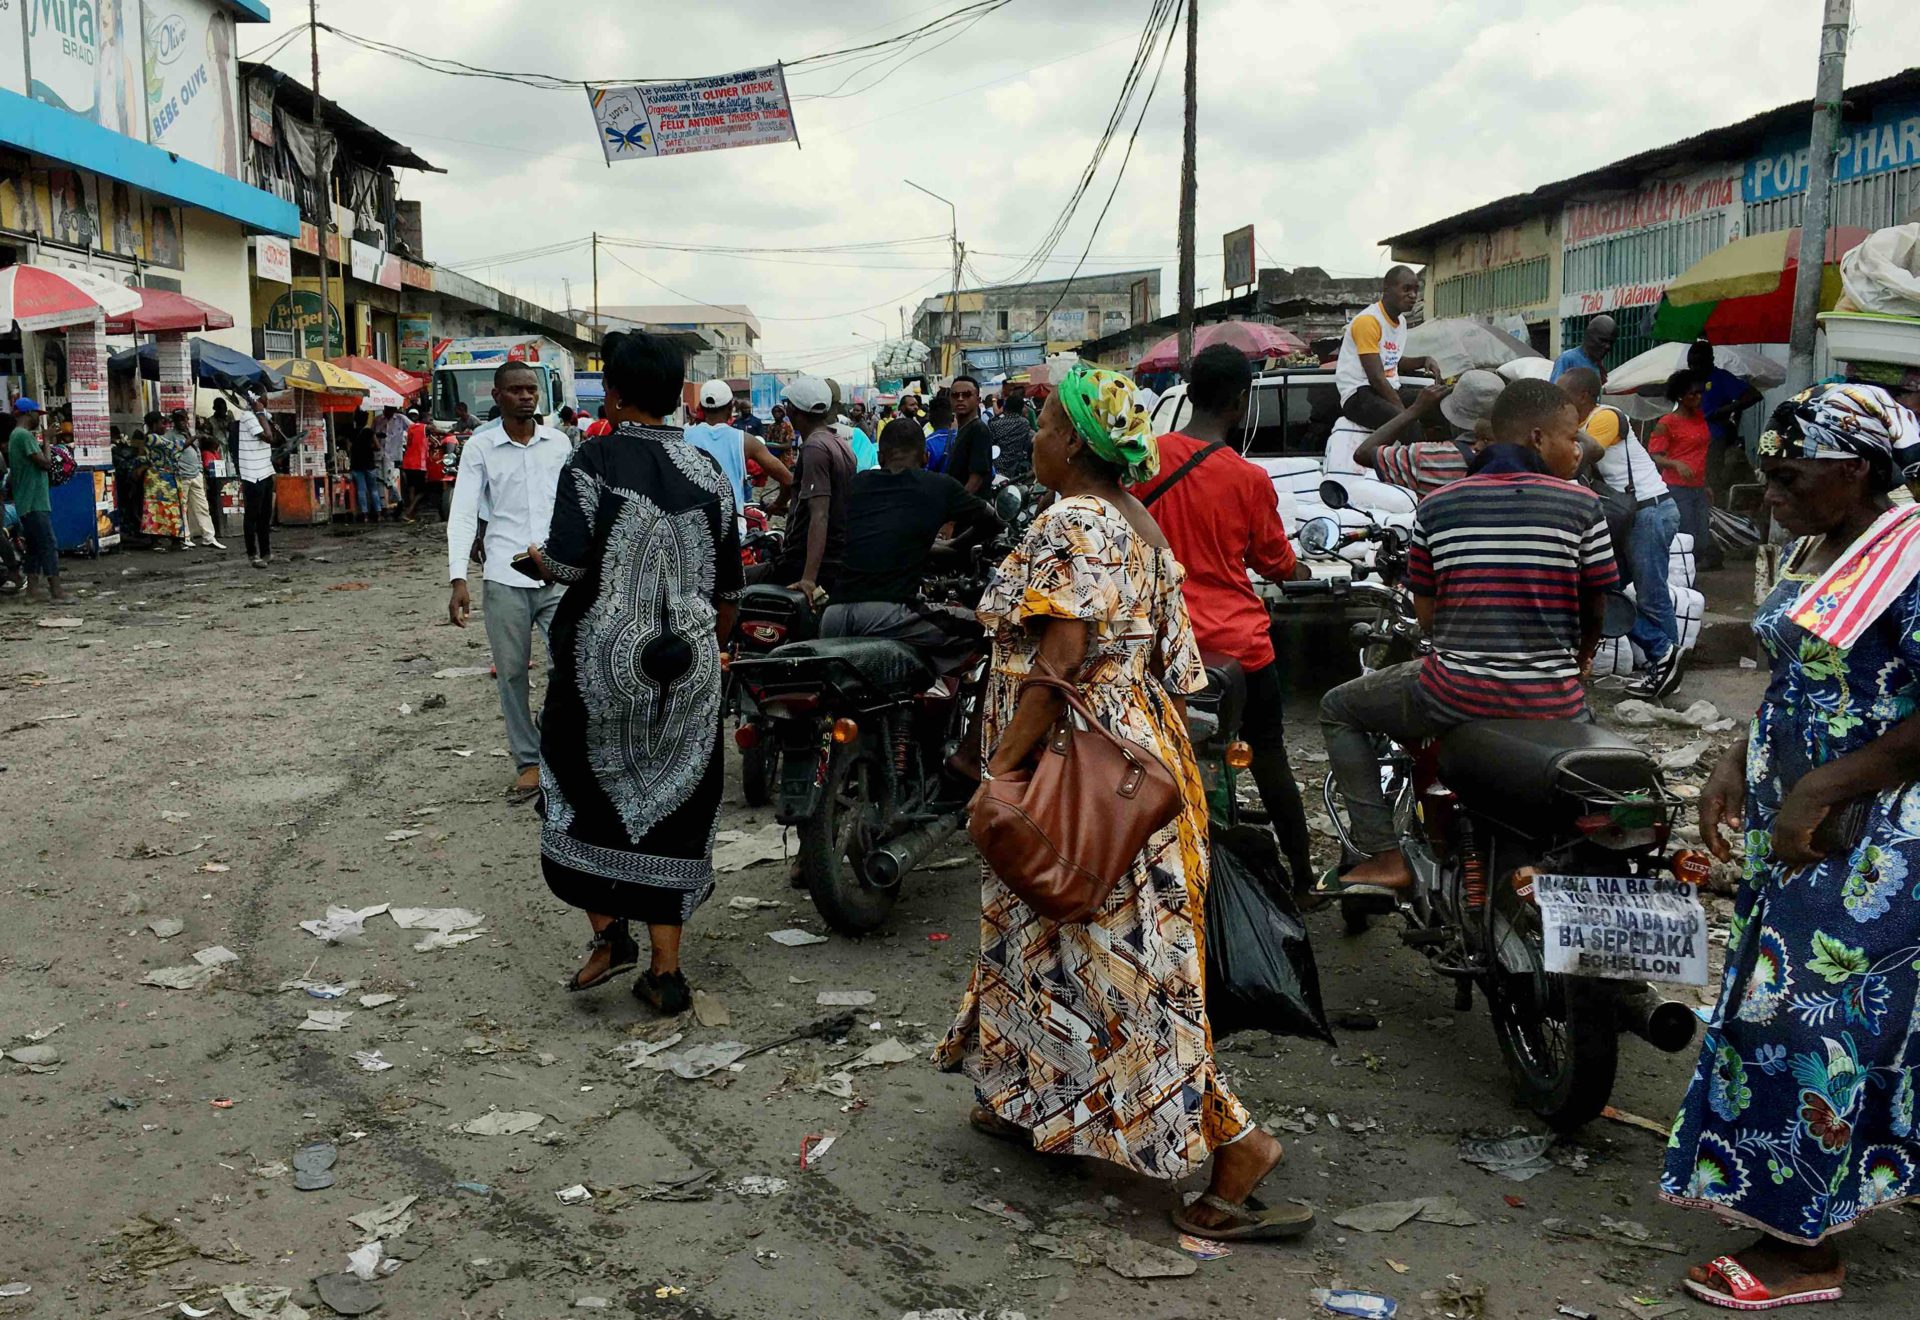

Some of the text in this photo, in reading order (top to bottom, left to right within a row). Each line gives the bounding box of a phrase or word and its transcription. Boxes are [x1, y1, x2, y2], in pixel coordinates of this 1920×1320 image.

[62, 38, 94, 66] BRAID
[152, 63, 208, 138] BEBE OLIVE
[703, 86, 738, 100] OLIVIER
[741, 80, 775, 96] KATENDE
[647, 105, 677, 115] Organise
[679, 104, 691, 112] une
[660, 117, 685, 131] FELIX
[688, 115, 725, 127] ANTOINE
[1596, 878, 1621, 895] NA
[1626, 878, 1649, 895] BA
[1615, 908, 1639, 930] NA
[1641, 912, 1663, 932] BA
[1559, 926, 1695, 958] BA SEPELAKA
[1579, 952, 1681, 975] ECHELLON
